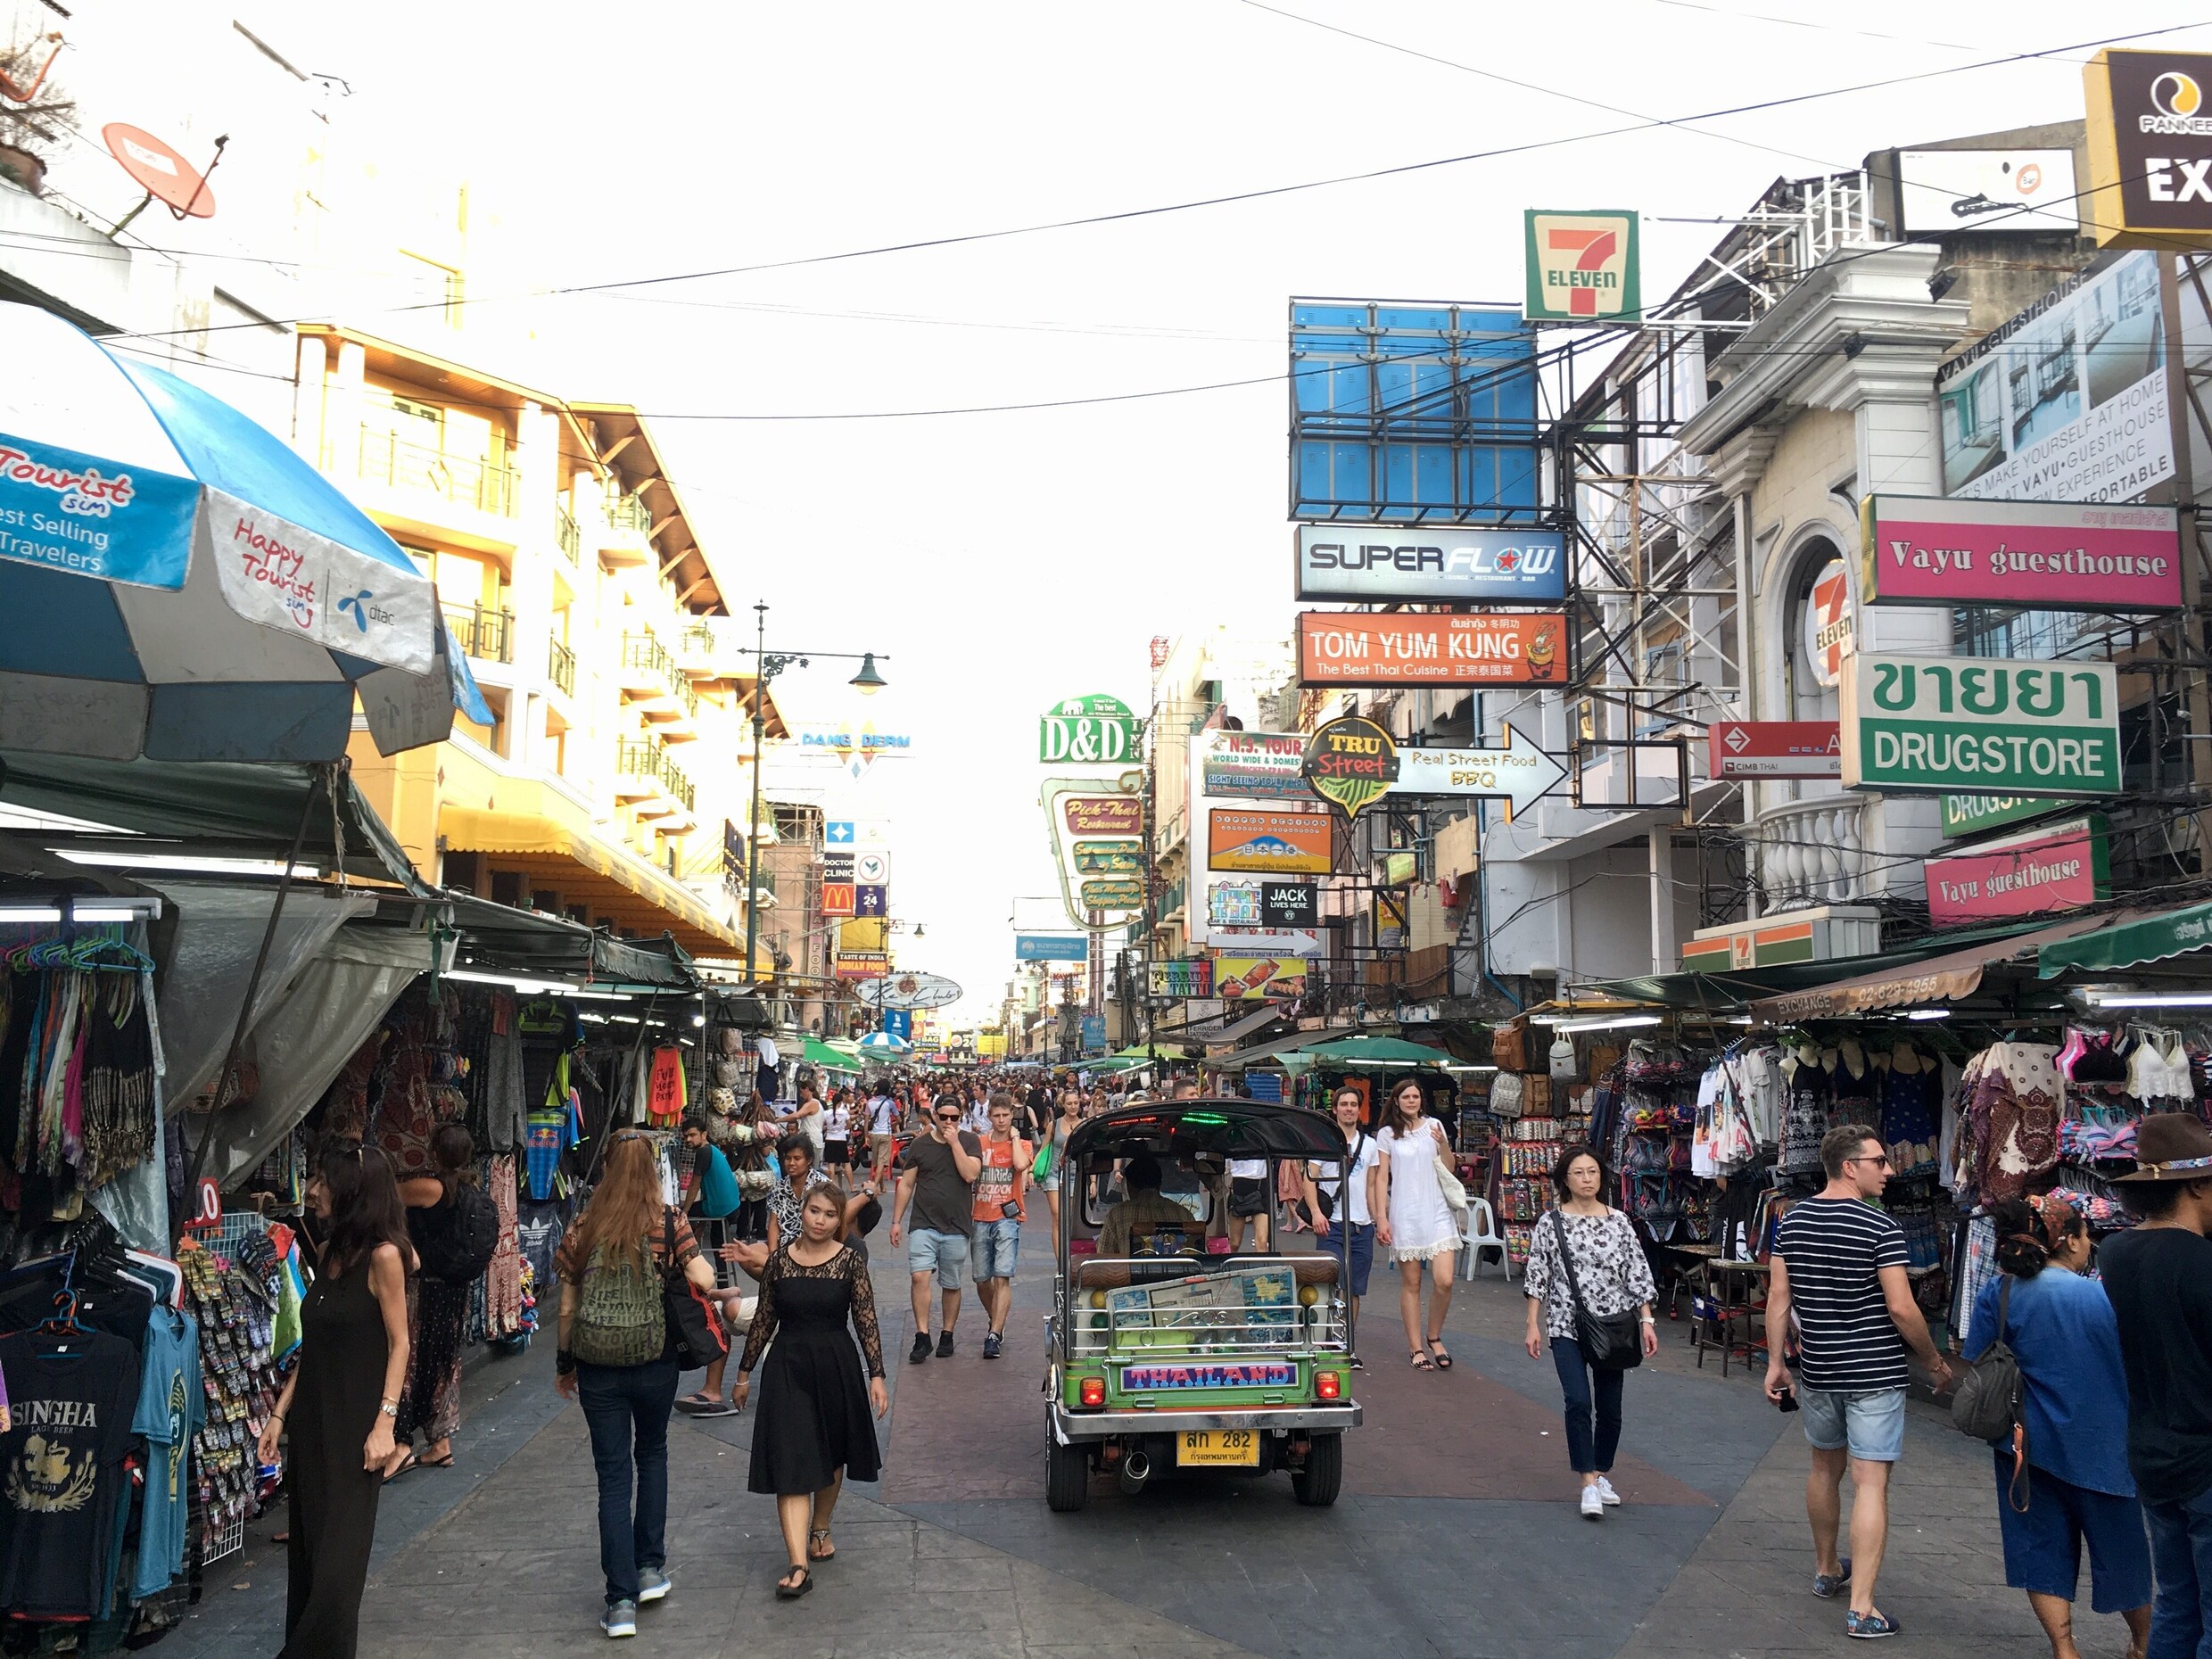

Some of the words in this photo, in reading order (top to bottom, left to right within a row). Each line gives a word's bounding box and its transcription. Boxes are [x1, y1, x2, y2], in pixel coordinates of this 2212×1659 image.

[1984, 459, 2019, 493] MAKE
[2022, 416, 2093, 466] YOURSELF
[2097, 403, 2116, 424] AT
[2119, 373, 2165, 414] HOME
[2057, 438, 2147, 500] EXPERIENCE
[31, 513, 109, 550] Selling
[0, 530, 102, 572] Travelers
[234, 517, 304, 578] Happy
[1888, 540, 1973, 575] Vayu
[1989, 542, 2168, 577] guesthouse
[242, 553, 316, 603] Tourist
[368, 605, 395, 626] dtac
[1309, 631, 1368, 658] TOM
[1378, 631, 1438, 658] YUM
[1449, 632, 1520, 659] KUNG
[1316, 662, 1340, 674] The
[1342, 663, 1371, 675] Best
[1373, 664, 1399, 675] Thai
[1403, 664, 1449, 675] Cuisine
[1455, 664, 1514, 676] 正宗泰国菜
[1872, 662, 2103, 720] ขายยา
[1043, 718, 1125, 762] D&D
[1328, 734, 1382, 755] TRU
[1213, 755, 1239, 763] WORLD
[1242, 755, 1261, 763] WIDE
[1264, 756, 1269, 764] &
[1273, 757, 1300, 766] DOMES
[1412, 751, 1443, 766] Real
[1448, 752, 1498, 766] Street
[1502, 754, 1538, 767] Food
[1874, 730, 2105, 777] DRUGSTORE
[1317, 753, 1386, 779] Street
[1736, 763, 1758, 771] CIMB
[1208, 774, 1231, 784] SIGHT
[1233, 775, 1260, 785] SEEING
[1261, 777, 1283, 786] TOUR
[1450, 771, 1498, 788] BBQ
[1077, 817, 1132, 830] Restaurant
[1215, 815, 1265, 824] NIPPON
[1270, 817, 1327, 827] ICHIBAN
[824, 859, 854, 867] DOCTOR
[824, 869, 854, 878] CLINIC
[1939, 879, 1979, 905] Vayu
[1985, 857, 2081, 899] guesthouse
[863, 896, 878, 905] 24
[1269, 888, 1308, 902] JACK
[838, 961, 865, 971] INDIAN
[866, 962, 886, 971] FOOD
[868, 981, 898, 1002] The
[912, 986, 956, 1002] Club
[1777, 995, 1831, 1015] EXCHANGE
[1130, 1366, 1289, 1389] THAILAND
[11, 1399, 97, 1428] SINGHA
[54, 1426, 74, 1434] BEER
[1222, 1432, 1250, 1449] 282
